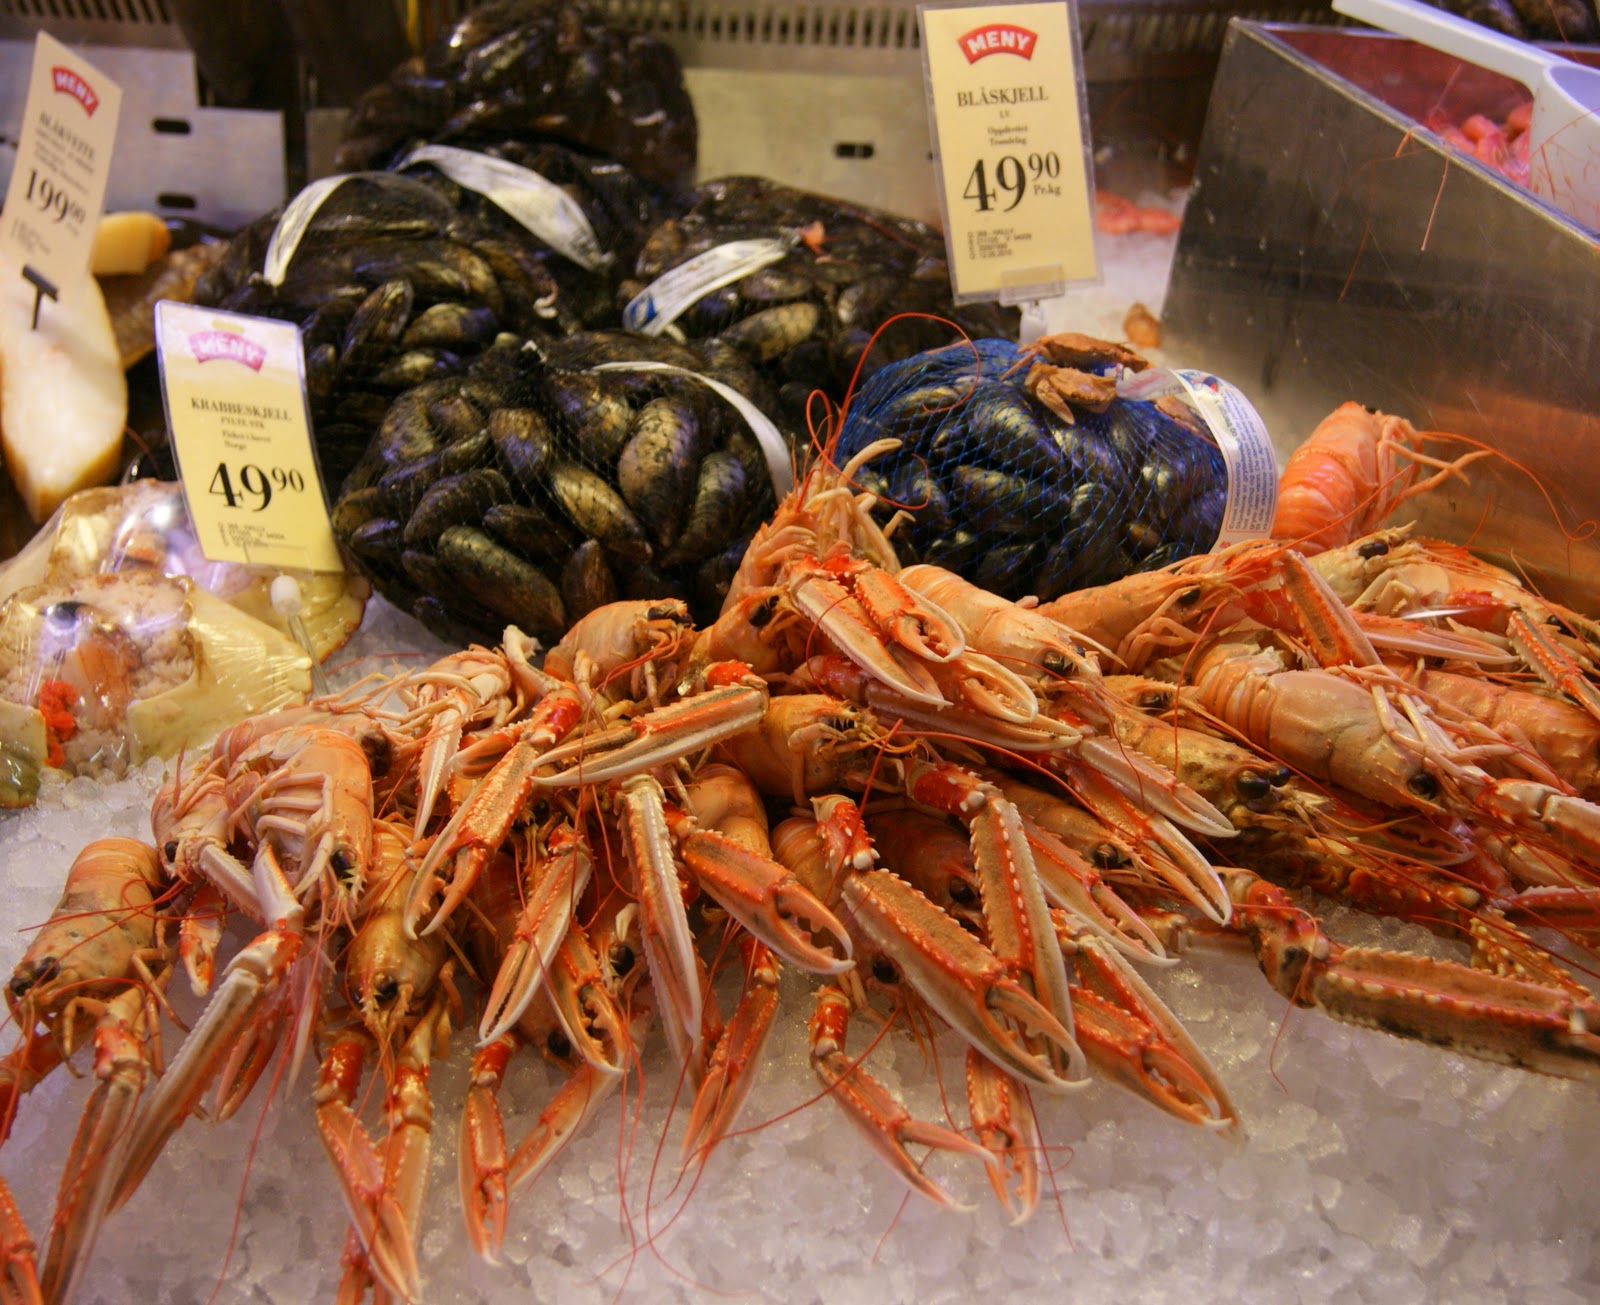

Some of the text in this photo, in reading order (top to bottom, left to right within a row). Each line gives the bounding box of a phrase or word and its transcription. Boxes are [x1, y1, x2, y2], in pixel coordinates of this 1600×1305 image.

[967, 30, 1031, 54] MENY
[54, 70, 95, 107] MENY
[957, 85, 1049, 107] BLÅSKJELL
[962, 155, 1027, 213] 49
[191, 397, 292, 421] KRABBESKJELL
[208, 461, 273, 513] 49
